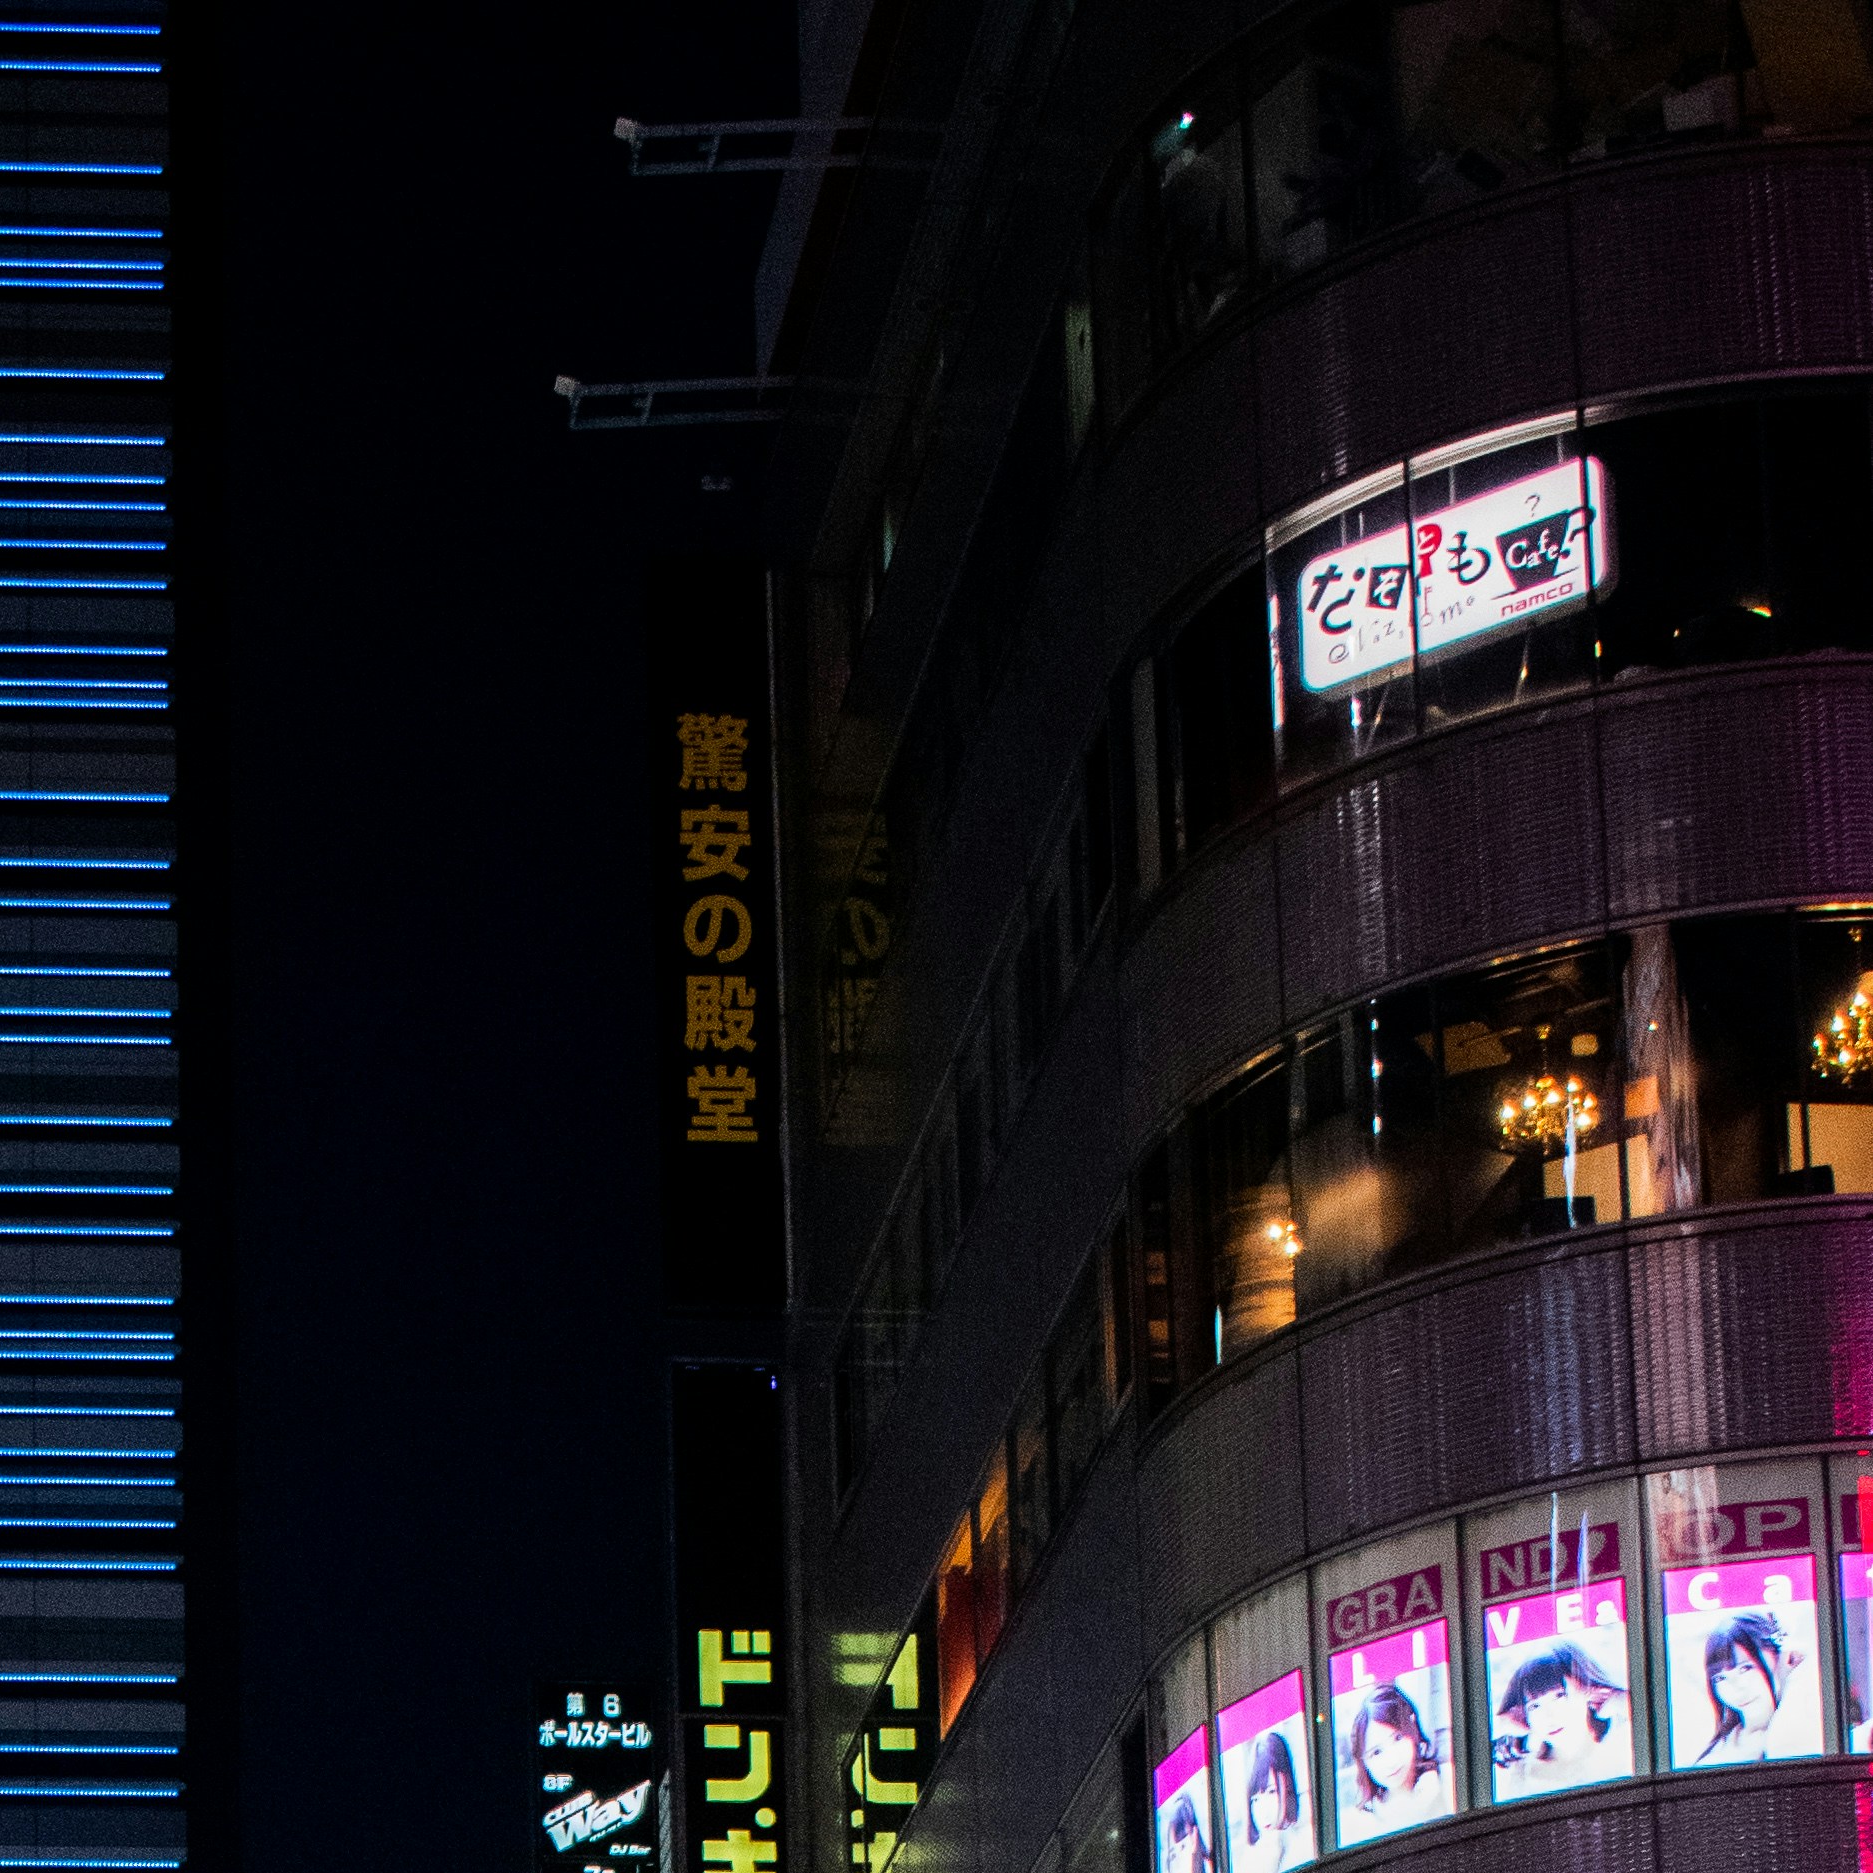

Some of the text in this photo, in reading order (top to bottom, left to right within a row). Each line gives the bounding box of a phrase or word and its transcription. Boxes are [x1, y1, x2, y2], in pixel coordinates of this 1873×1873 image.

[1499, 582, 1575, 619] namco
[676, 712, 759, 1143] 驚安の殿堂
[546, 1779, 652, 1852] Way
